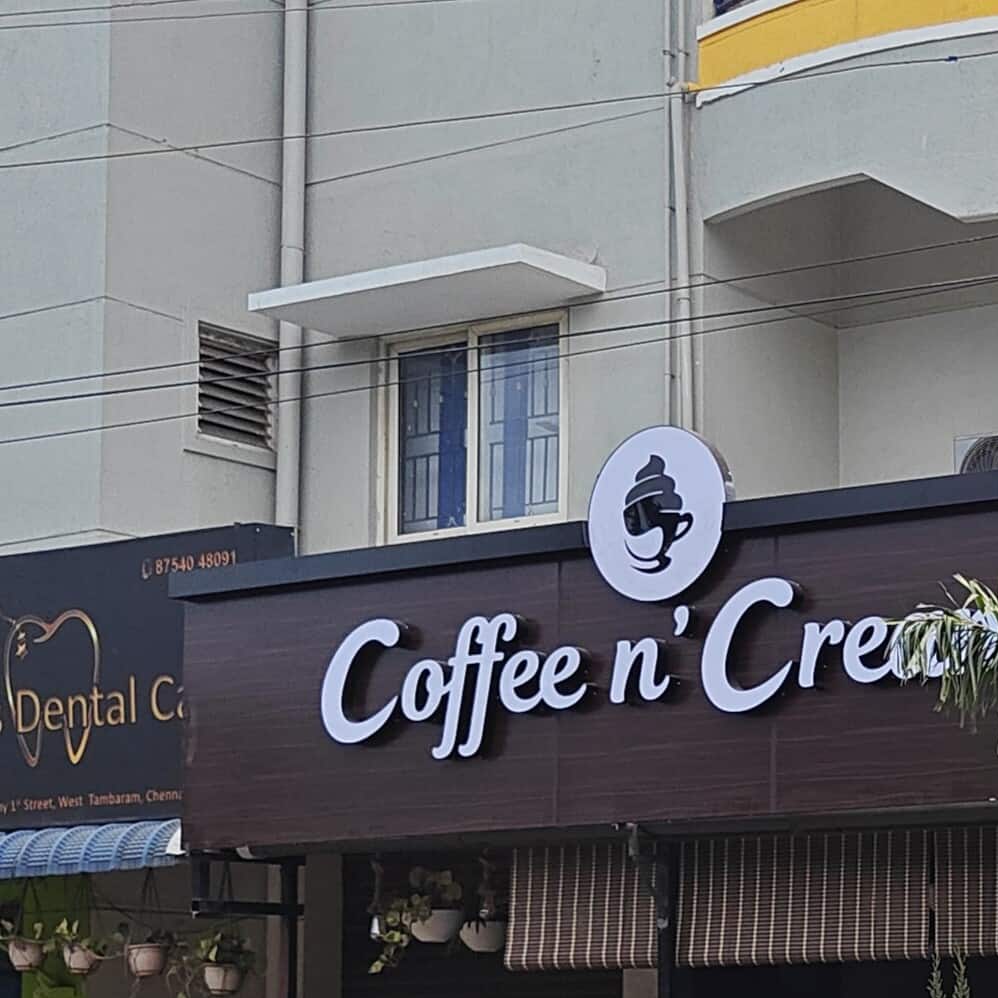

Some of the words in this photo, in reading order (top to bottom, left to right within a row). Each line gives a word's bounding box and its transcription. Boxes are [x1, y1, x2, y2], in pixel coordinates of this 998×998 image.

[155, 556, 194, 575] 87540
[199, 550, 235, 569] 48091
[16, 675, 135, 733] Dental
[321, 613, 587, 759] Coffee
[58, 796, 82, 808] West
